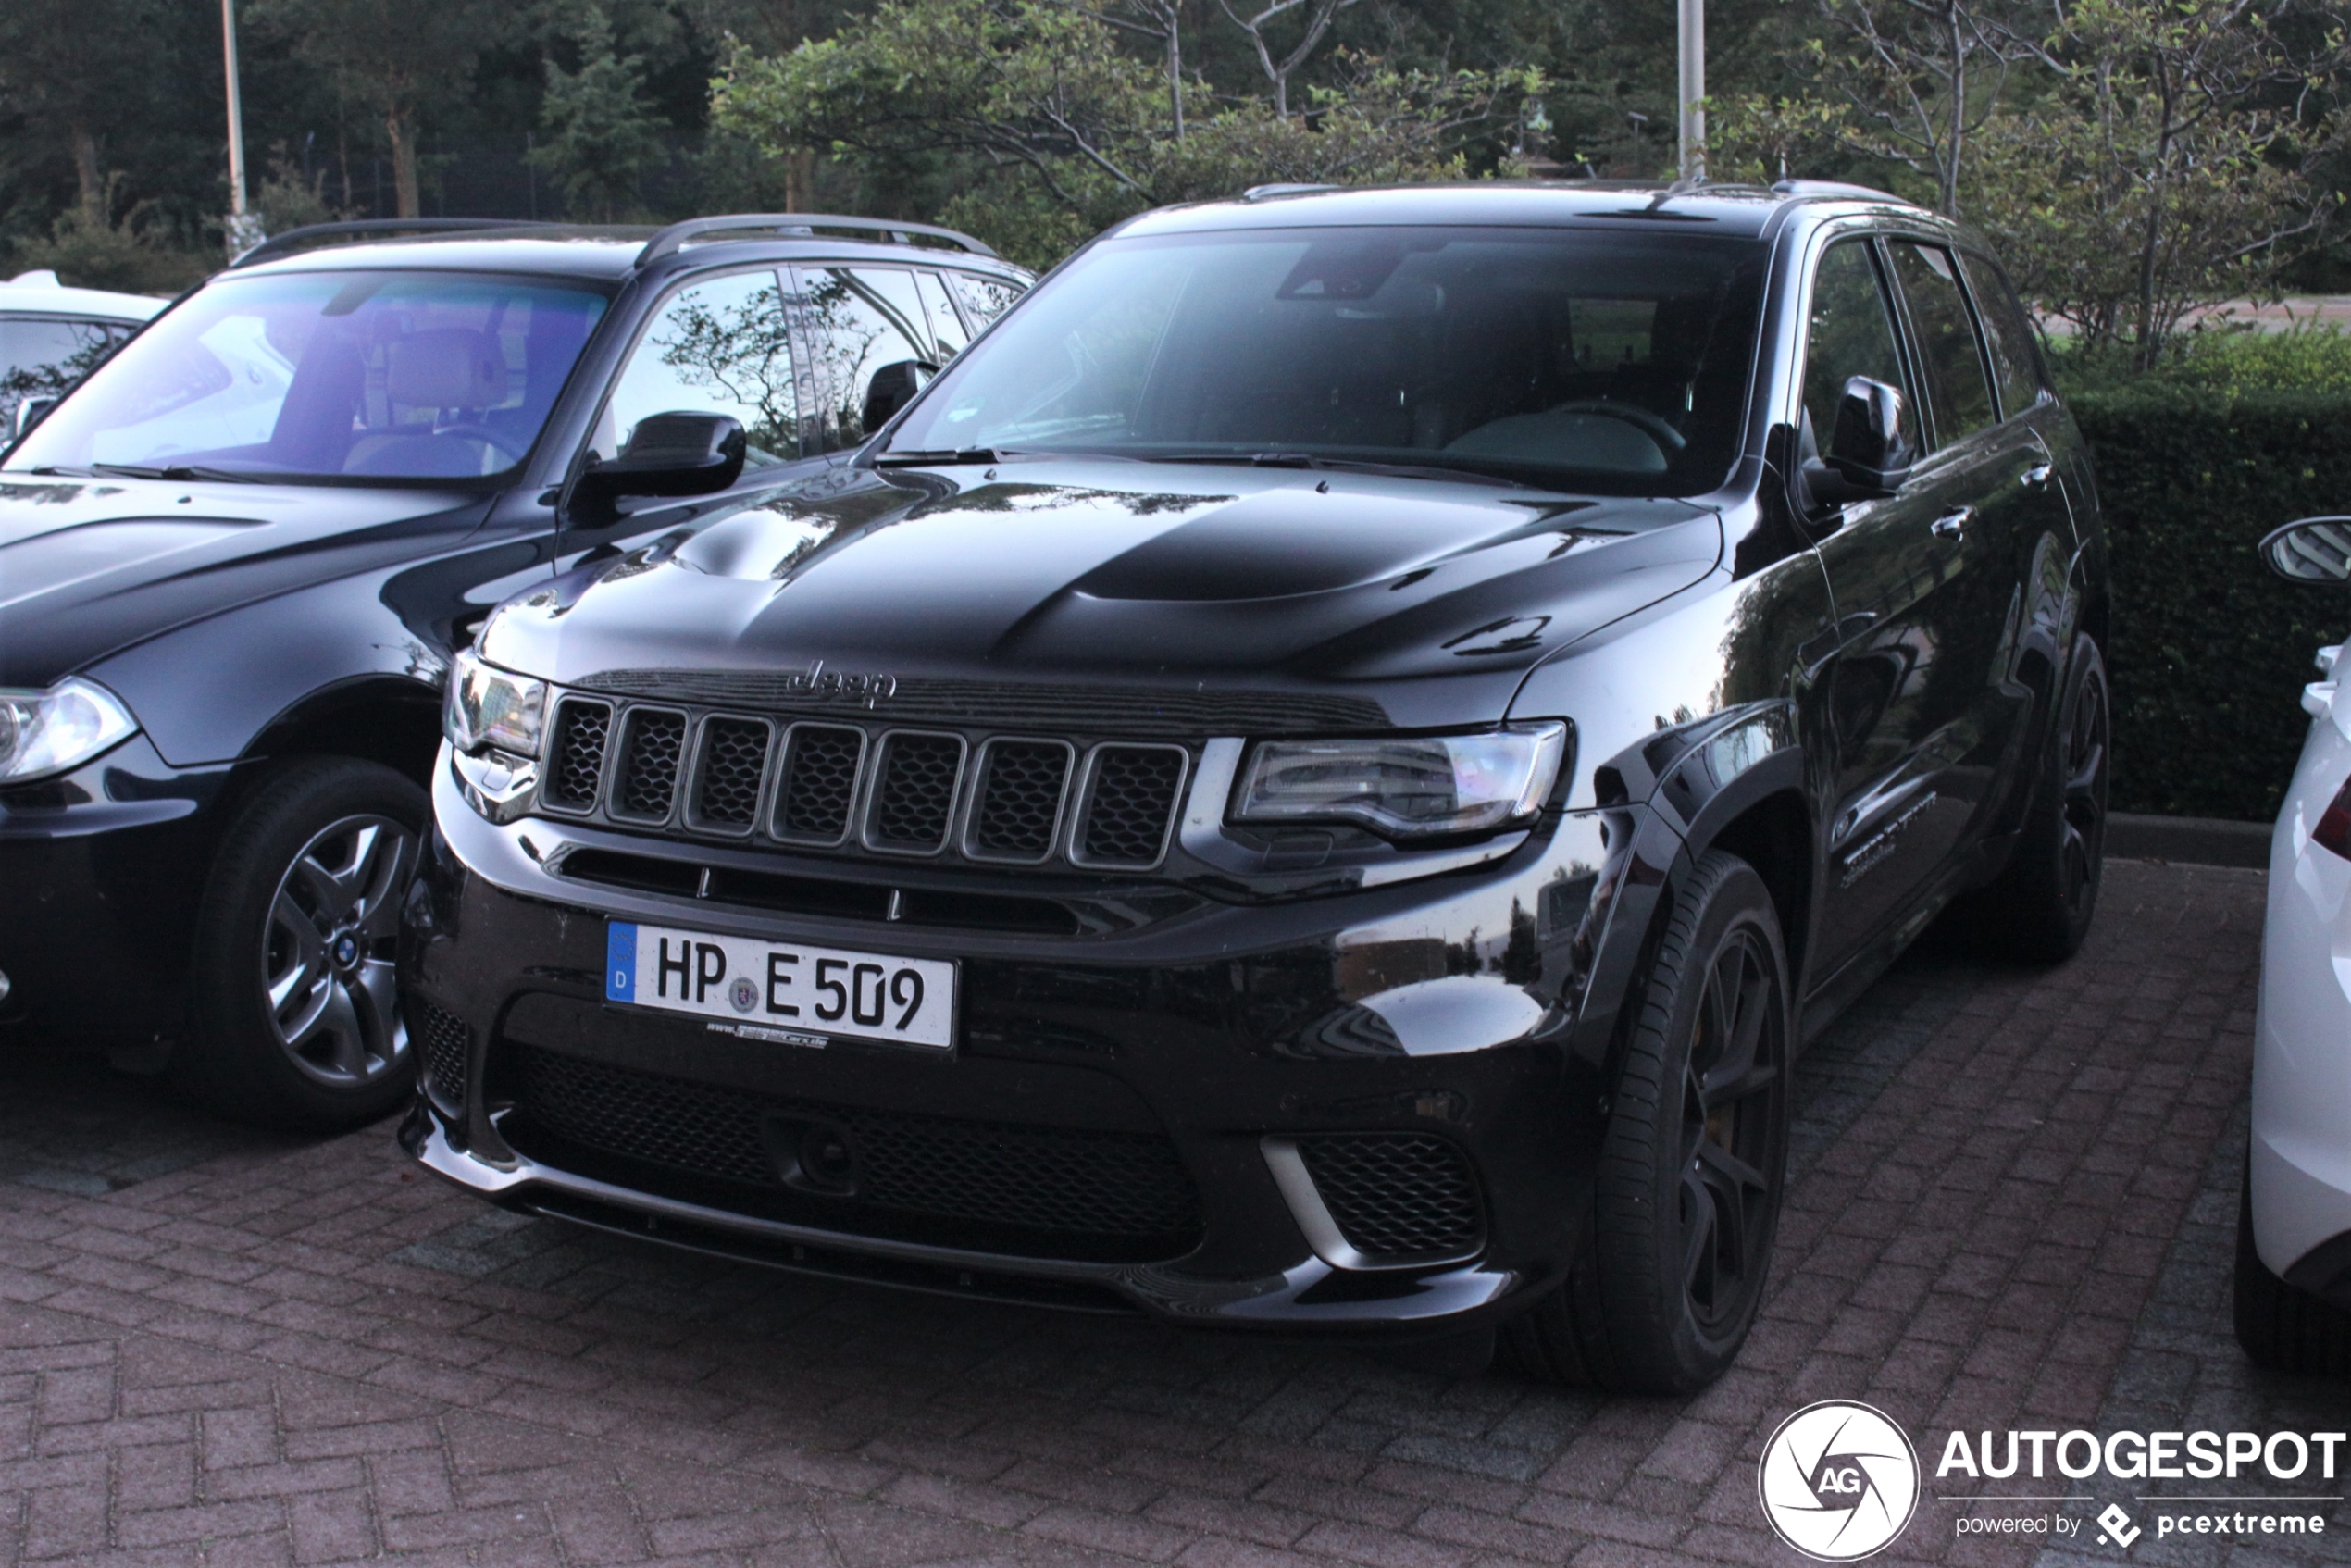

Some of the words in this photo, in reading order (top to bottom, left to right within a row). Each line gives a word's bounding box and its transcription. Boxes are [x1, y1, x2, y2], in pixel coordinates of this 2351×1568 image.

[787, 660, 897, 710] Jeep
[615, 972, 626, 989] D
[658, 937, 727, 1002] HP
[767, 952, 800, 1016] E
[815, 958, 925, 1030] 509
